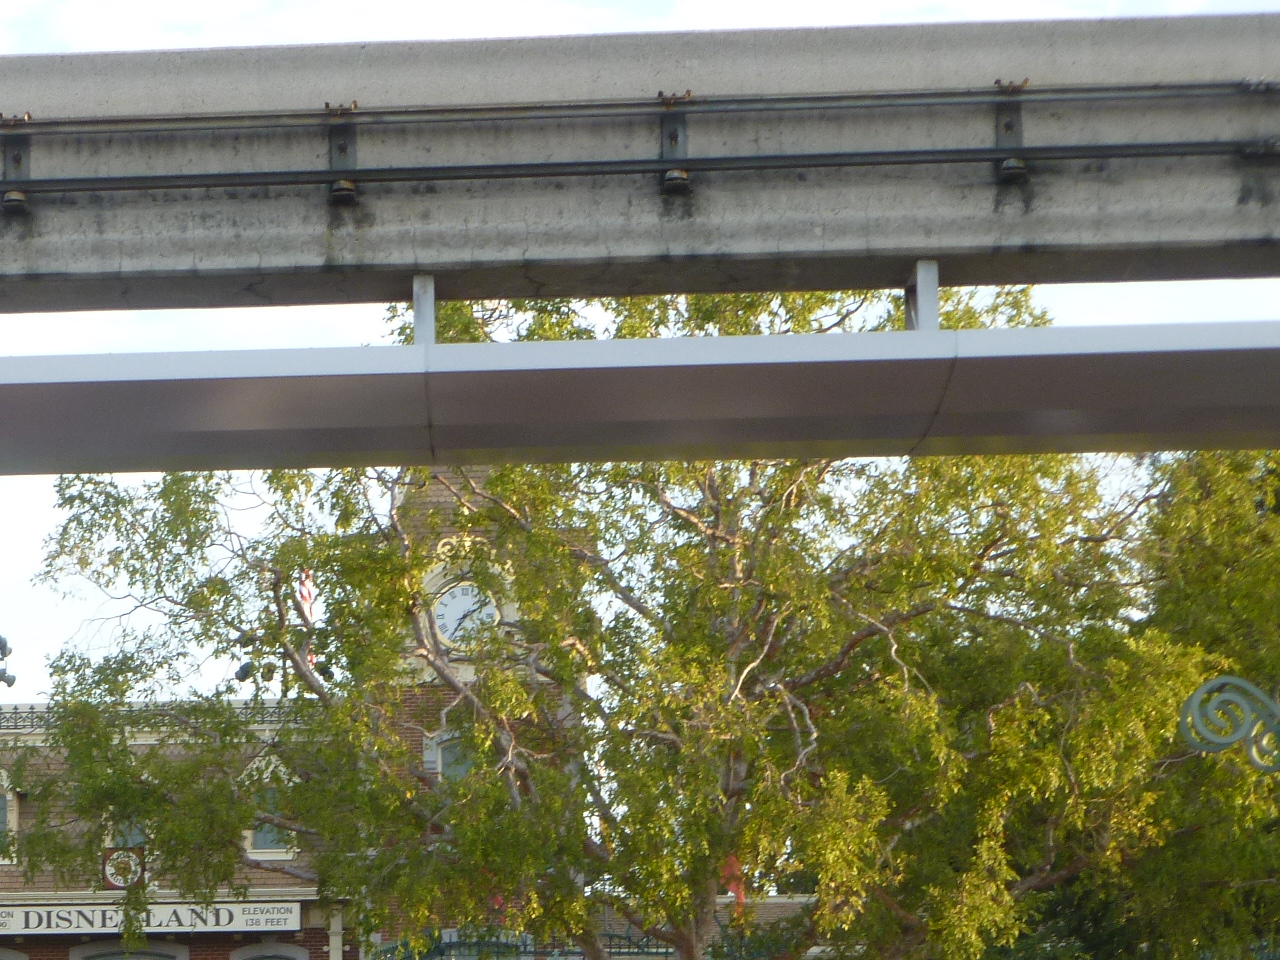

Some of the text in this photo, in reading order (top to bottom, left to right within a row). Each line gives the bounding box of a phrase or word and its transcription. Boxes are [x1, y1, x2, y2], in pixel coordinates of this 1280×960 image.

[242, 906, 293, 916] ELEVATION
[22, 907, 235, 930] DISNELAND
[245, 917, 289, 927] 138 FEET
